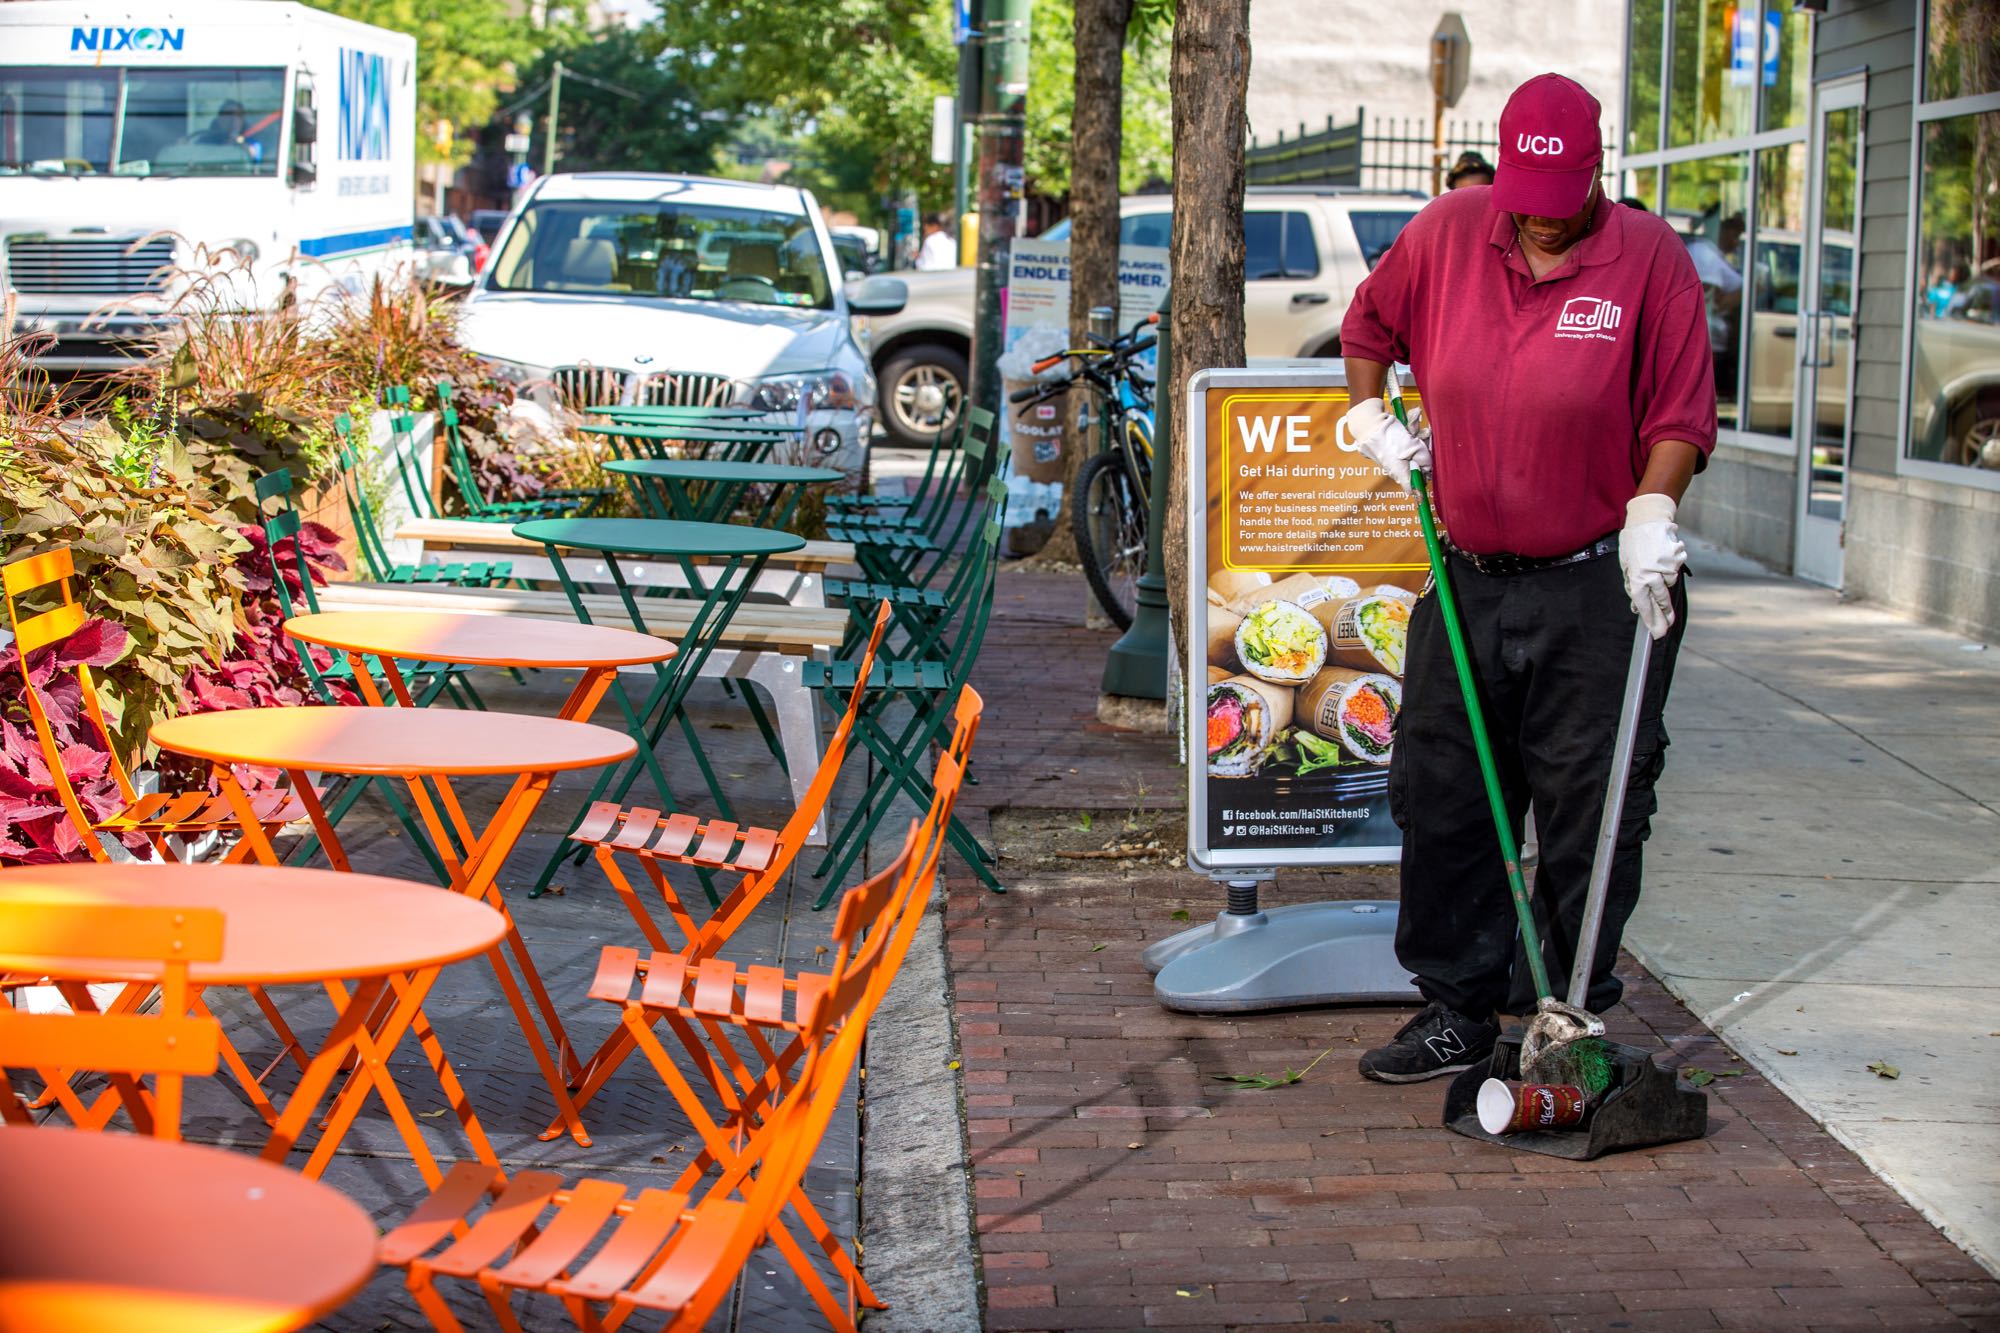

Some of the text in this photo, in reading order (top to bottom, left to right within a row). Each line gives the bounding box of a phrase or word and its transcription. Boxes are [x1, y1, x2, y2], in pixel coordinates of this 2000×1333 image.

[71, 28, 184, 50] NIXON
[1517, 133, 1564, 155] UCD
[1014, 254, 1059, 263] ENDLESS
[1013, 266, 1072, 281] ENDLE
[1563, 304, 1600, 326] ucd
[1554, 332, 1583, 340] University
[1596, 333, 1616, 342] District
[1236, 415, 1312, 453] WE
[1240, 465, 1261, 477] Get
[1266, 465, 1287, 477] Hai
[1292, 465, 1335, 479] during
[1340, 467, 1368, 479] your
[1240, 490, 1409, 500] We offer several ridiculously yummy
[1240, 504, 1253, 513] for
[1255, 506, 1272, 515] any
[1275, 504, 1317, 513] business
[1363, 503, 1387, 512] work
[1389, 503, 1415, 511] event
[1240, 517, 1271, 526] handle
[1274, 517, 1289, 526] the
[1331, 516, 1363, 525] matter
[1365, 516, 1385, 525] how
[1387, 516, 1412, 526] large
[1240, 530, 1255, 539] For
[1258, 531, 1283, 539] more
[1286, 529, 1317, 539] details
[1320, 529, 1346, 538] make
[1372, 529, 1381, 538] to
[1383, 529, 1411, 538] check
[1240, 542, 1364, 552] www.haistreetkitchen.com
[1235, 808, 1370, 820] facebook.com/HaiStKitchenUS
[1425, 1028, 1466, 1062] N
